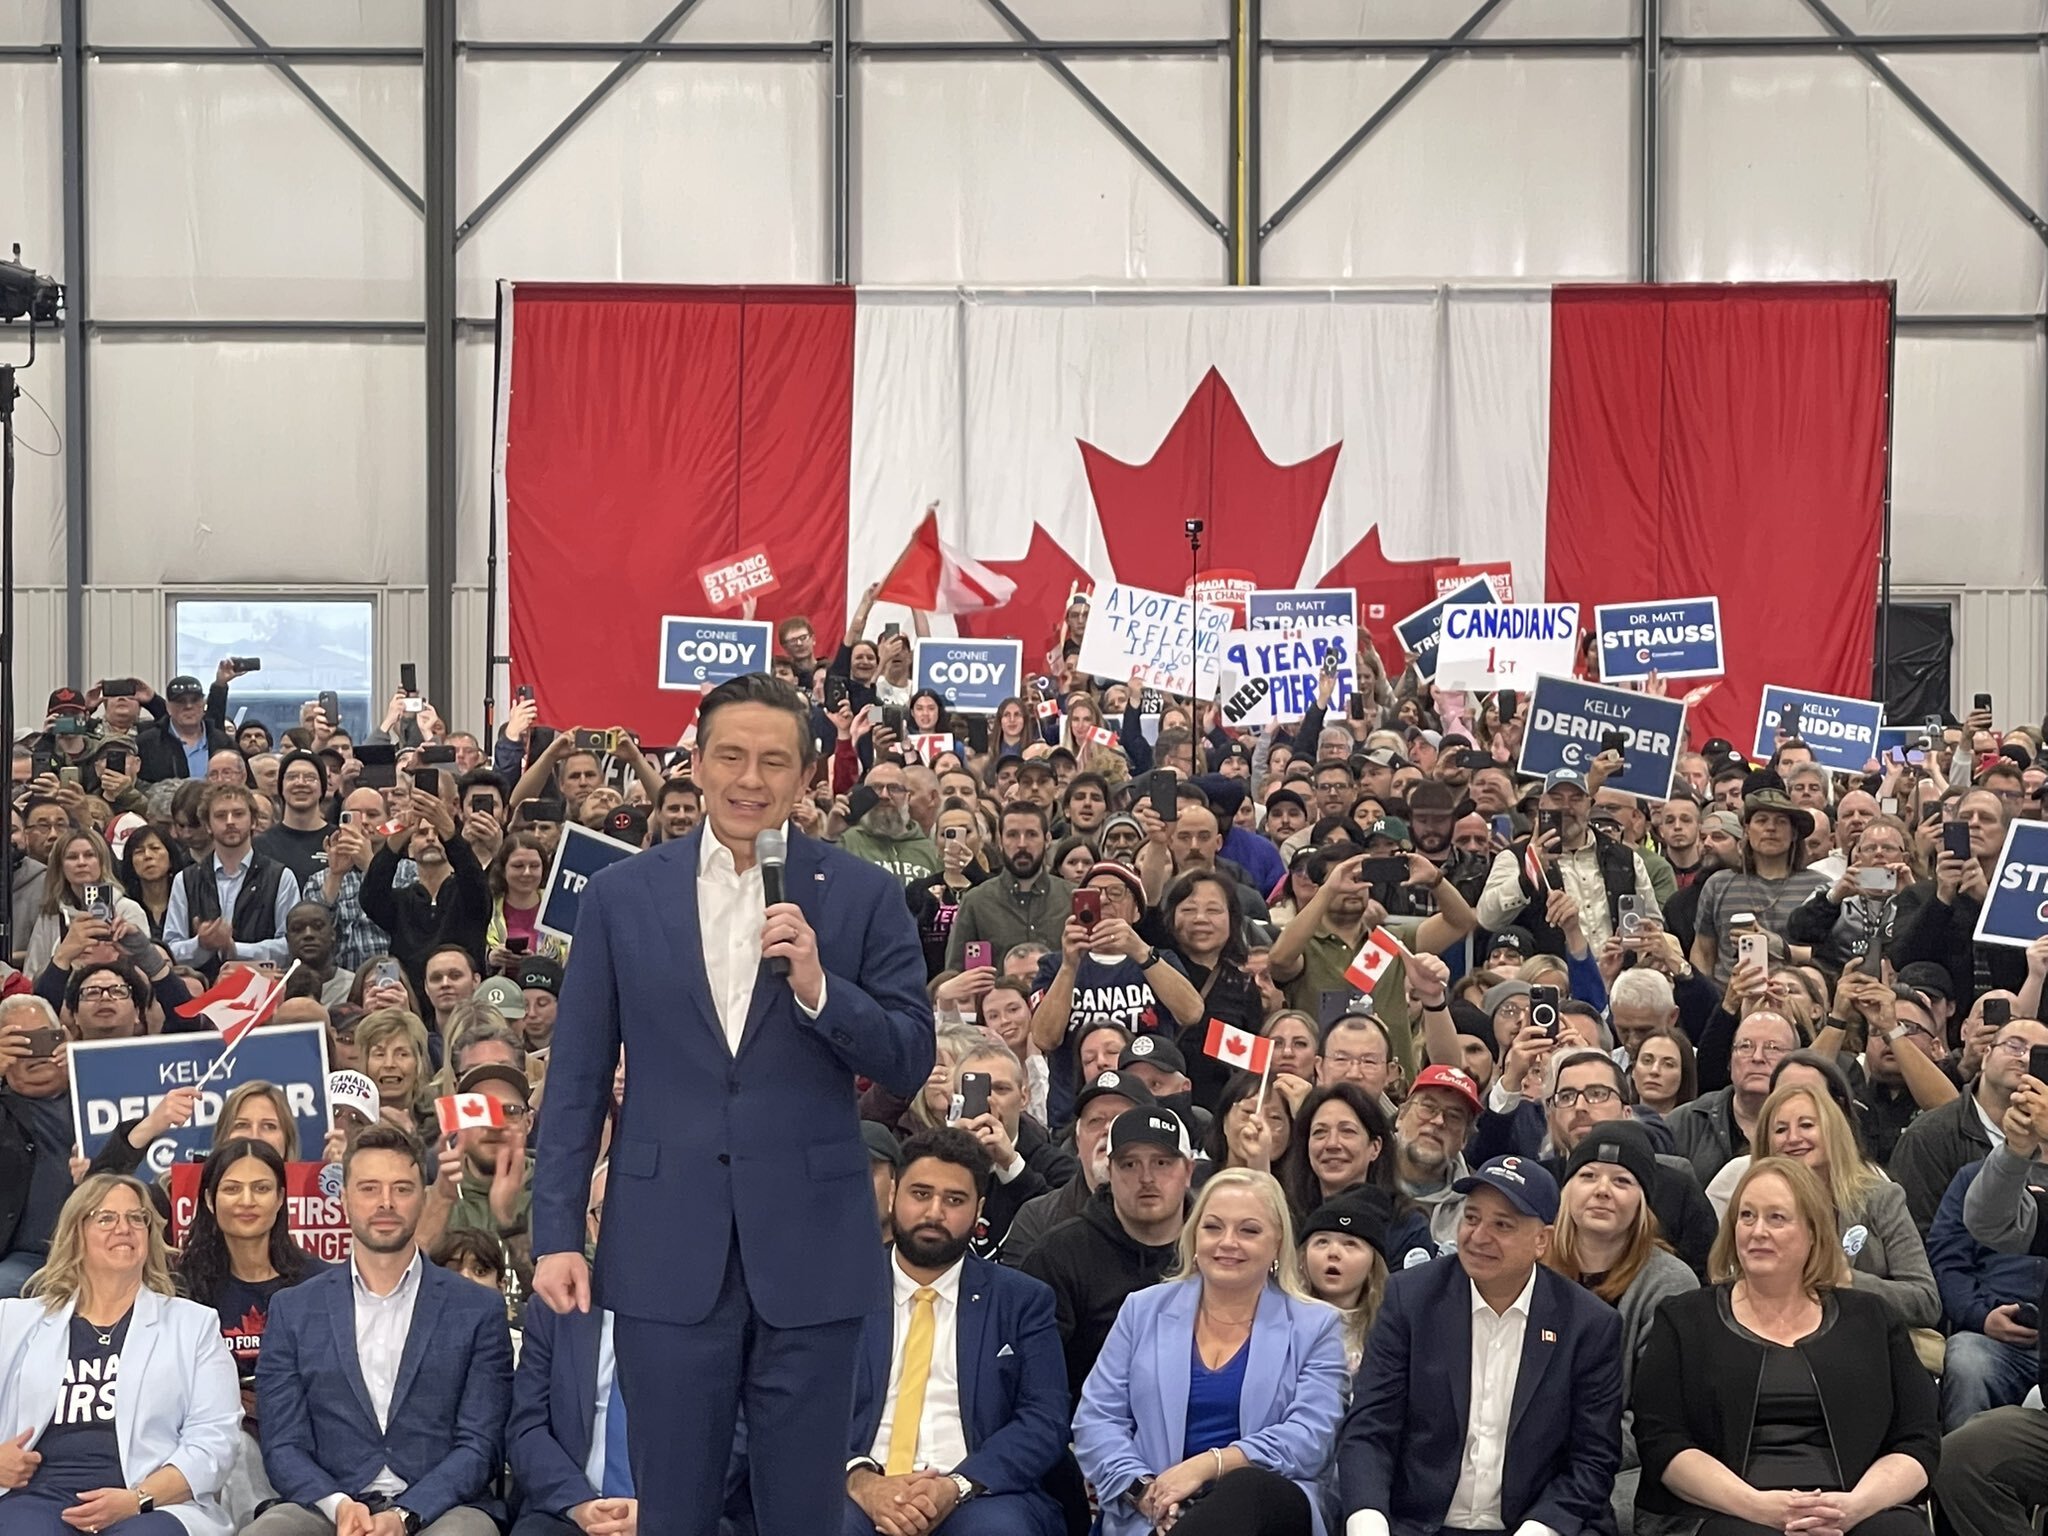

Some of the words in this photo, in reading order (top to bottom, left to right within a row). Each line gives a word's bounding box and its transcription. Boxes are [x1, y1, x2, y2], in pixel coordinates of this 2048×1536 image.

[703, 554, 767, 589] STRONG
[725, 566, 775, 598] FREE
[1215, 590, 1245, 601] CHAN
[1276, 602, 1294, 611] DR.
[1296, 601, 1326, 611] MATT
[1105, 587, 1118, 611] A
[1129, 590, 1191, 625] VOTE
[1197, 607, 1230, 632] FOR
[1630, 614, 1649, 625] DR.
[1652, 611, 1685, 624] MATT
[696, 629, 738, 641] CONNIE
[1252, 614, 1352, 631] STRAUSS
[1447, 606, 1577, 640] CANADIANS
[1412, 630, 1441, 654] TRE
[1603, 623, 1715, 649] STRAUSS
[677, 640, 757, 665] CODY
[947, 650, 989, 661] CONNIE
[1172, 649, 1220, 674] VOE
[1227, 643, 1250, 676] 9
[1255, 636, 1347, 675] YEARS
[929, 661, 1006, 685] CODY
[1223, 677, 1269, 723] NEED
[1269, 669, 1353, 716] PIERE
[1584, 698, 1631, 719] KELLY
[1802, 702, 1840, 717] KELLY
[1765, 710, 1872, 744] DRIDDER
[563, 868, 588, 893] TR
[2000, 862, 2048, 893] ST
[1071, 983, 1156, 1010] CANADA
[1068, 1007, 1144, 1033] FIRST
[160, 1057, 237, 1085] KELLY
[331, 1075, 371, 1092] CANADA
[330, 1083, 362, 1097] FIRST
[236, 1335, 260, 1349] FOR
[62, 1353, 120, 1384] ANA
[54, 1381, 116, 1425] IRS
